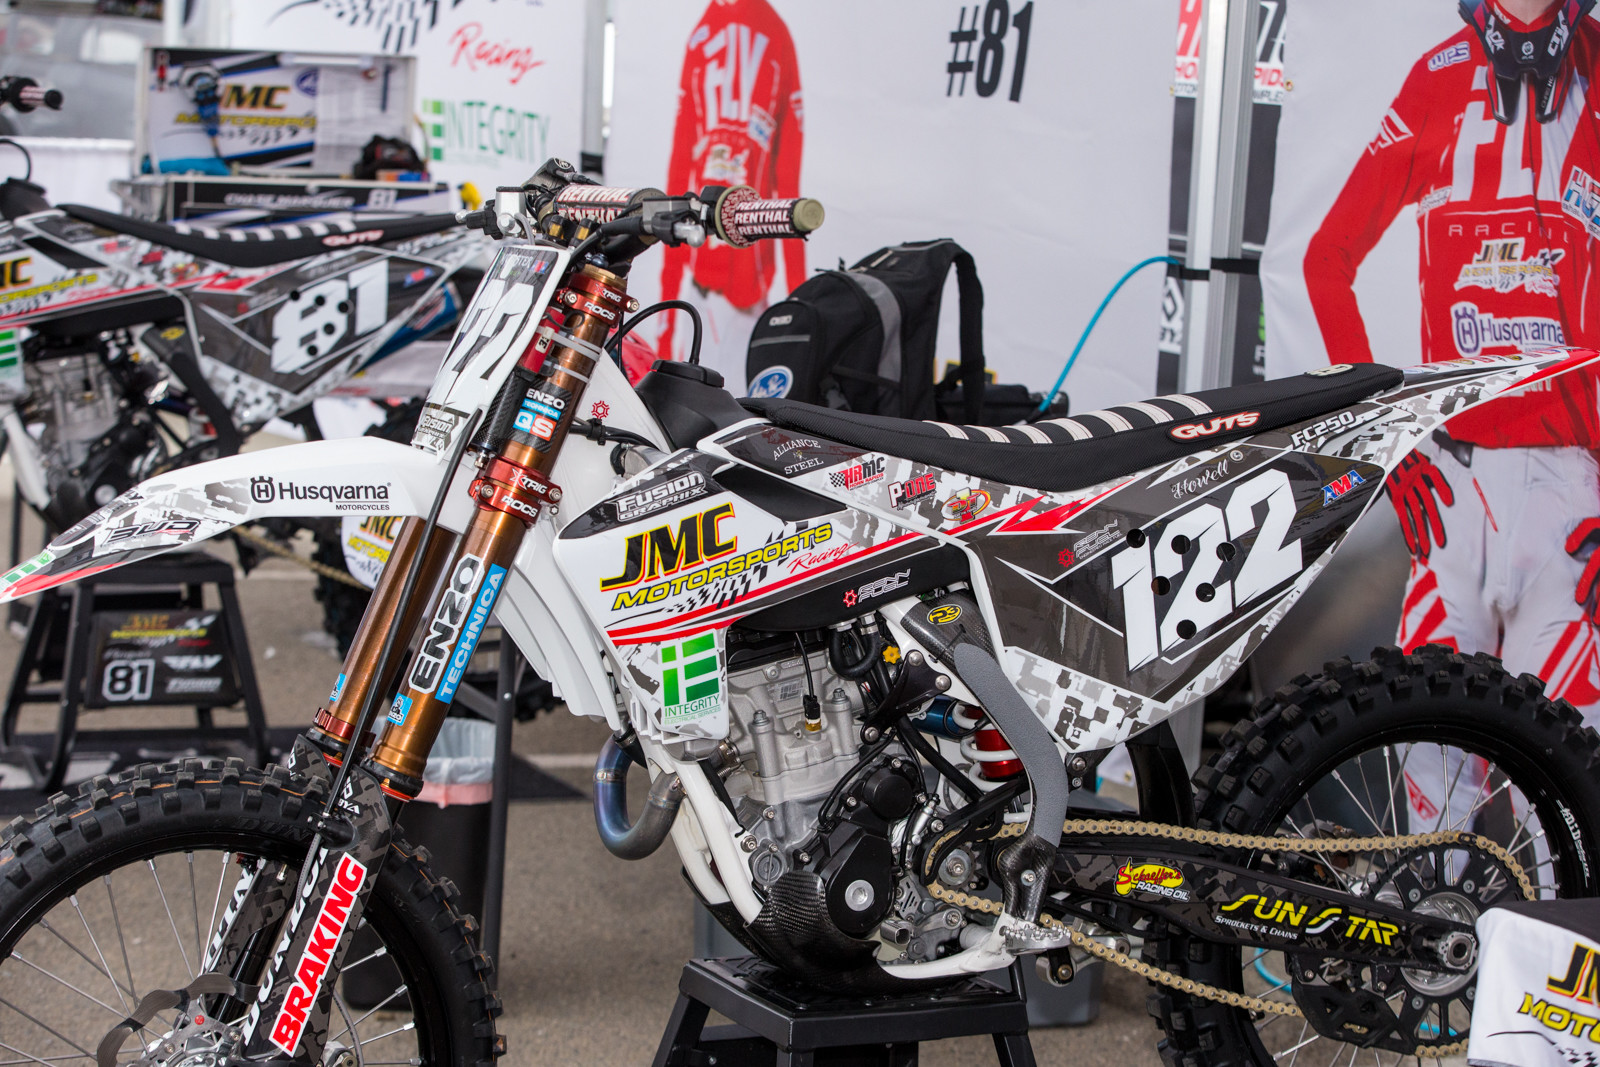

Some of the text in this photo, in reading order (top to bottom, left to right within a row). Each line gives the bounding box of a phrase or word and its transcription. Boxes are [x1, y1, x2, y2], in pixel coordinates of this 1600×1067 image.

[449, 22, 546, 84] Racing
[946, 0, 1033, 103] #81
[222, 84, 290, 111] MC
[557, 184, 634, 202] RENTHAL
[736, 199, 793, 211] RENTHAL
[734, 209, 790, 224] RENTHAL
[738, 223, 794, 236] RENTHAL
[271, 259, 389, 374] 81
[584, 301, 616, 320] ROCS
[1480, 318, 1565, 345] Husqvarna
[526, 388, 565, 409] ENZO
[1171, 411, 1260, 439] GUTS
[1291, 411, 1355, 449] FC250
[773, 438, 821, 461] ALLIANCE
[784, 457, 824, 475] STEEL
[1171, 459, 1229, 499] Howell
[279, 482, 389, 502] Husqvarna
[617, 472, 705, 513] FUSION
[1321, 469, 1366, 506] AMA
[501, 495, 538, 517] ROCS
[620, 486, 705, 520] GRAPHIX
[600, 502, 738, 591] JMC
[787, 541, 859, 573] Racing
[612, 521, 833, 611] MOTORSPORTS
[1111, 468, 1303, 672] 122
[409, 553, 484, 693] ENZO
[438, 571, 504, 698] TECHNICA
[103, 660, 154, 700] 81
[664, 694, 719, 717] INTEGRITY
[1116, 865, 1182, 885] Schaeffer's
[1136, 881, 1190, 901] RACING OIL
[1214, 914, 1298, 940] SPROCKETS & CHAINS
[271, 855, 365, 1054] BRAKING
